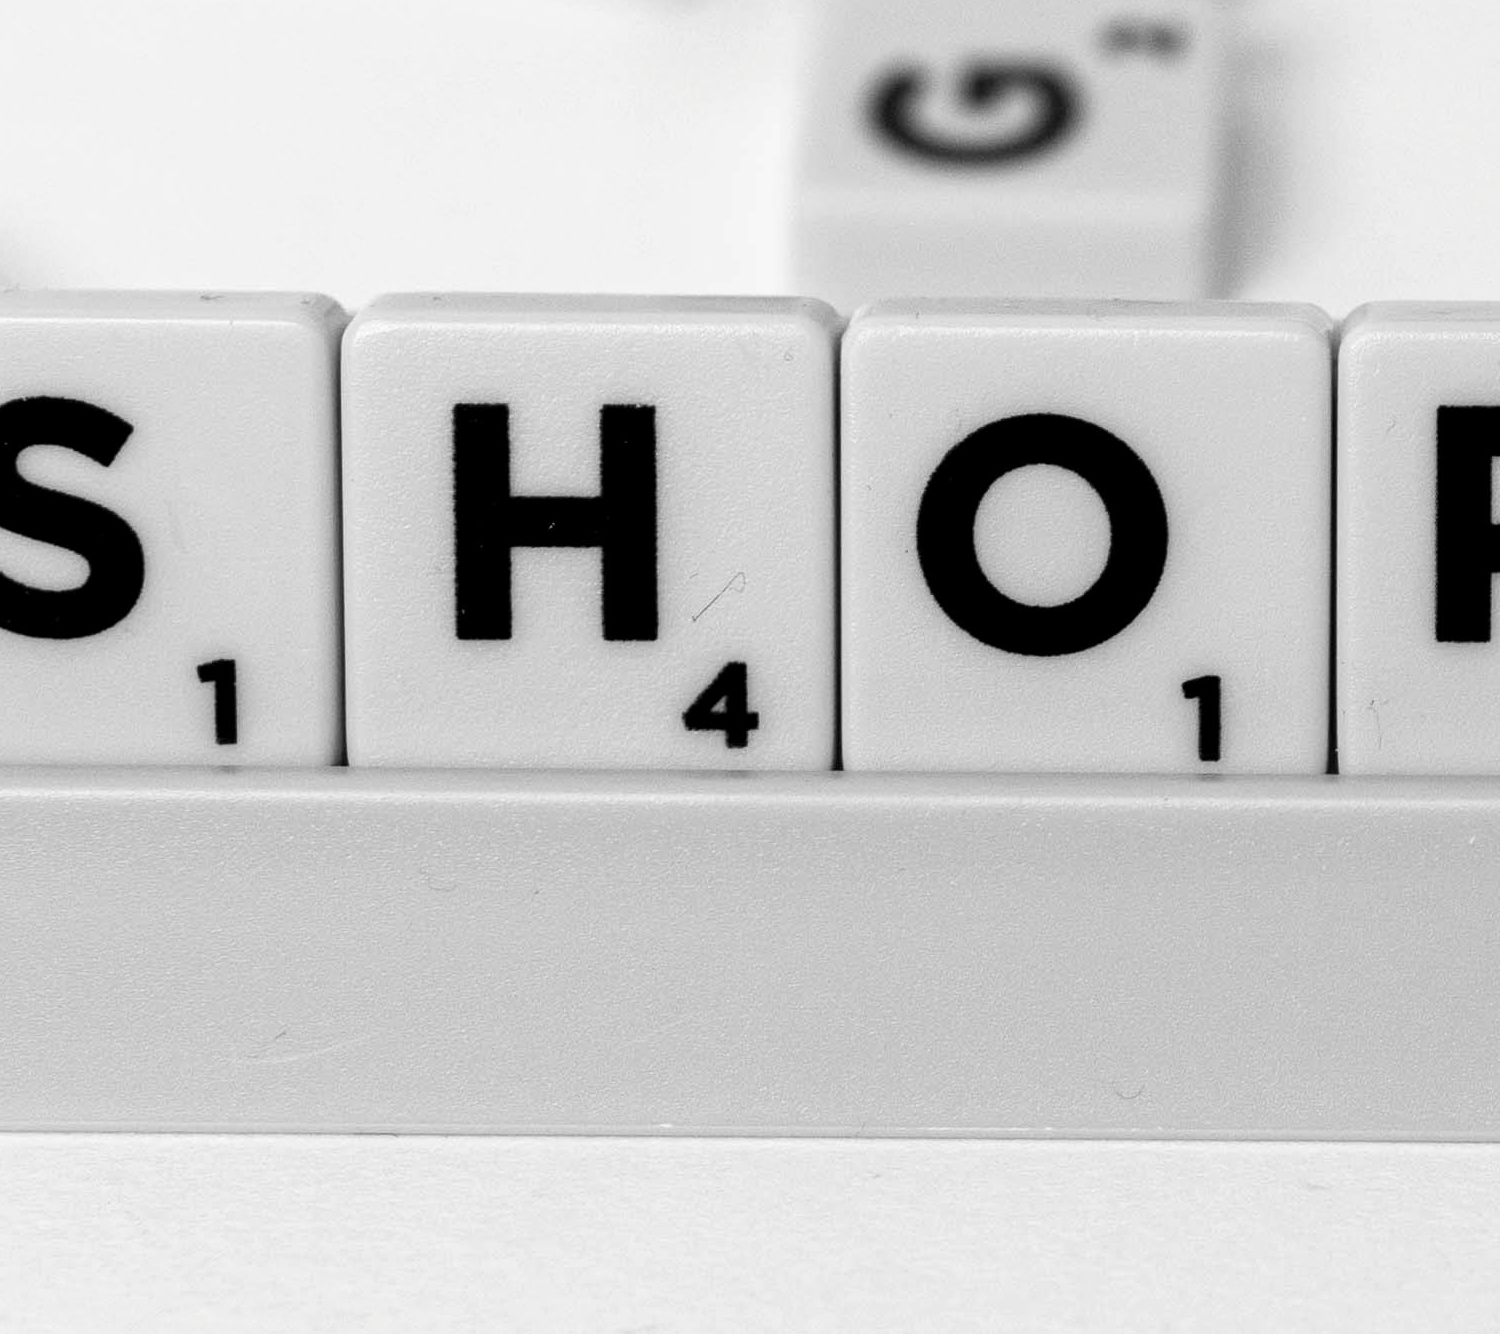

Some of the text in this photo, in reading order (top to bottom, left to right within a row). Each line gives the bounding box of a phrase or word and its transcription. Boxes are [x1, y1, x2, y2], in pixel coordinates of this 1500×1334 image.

[864, 61, 1084, 172] G
[195, 658, 238, 746] 1
[681, 661, 760, 749] 4
[1181, 674, 1222, 763] 1
